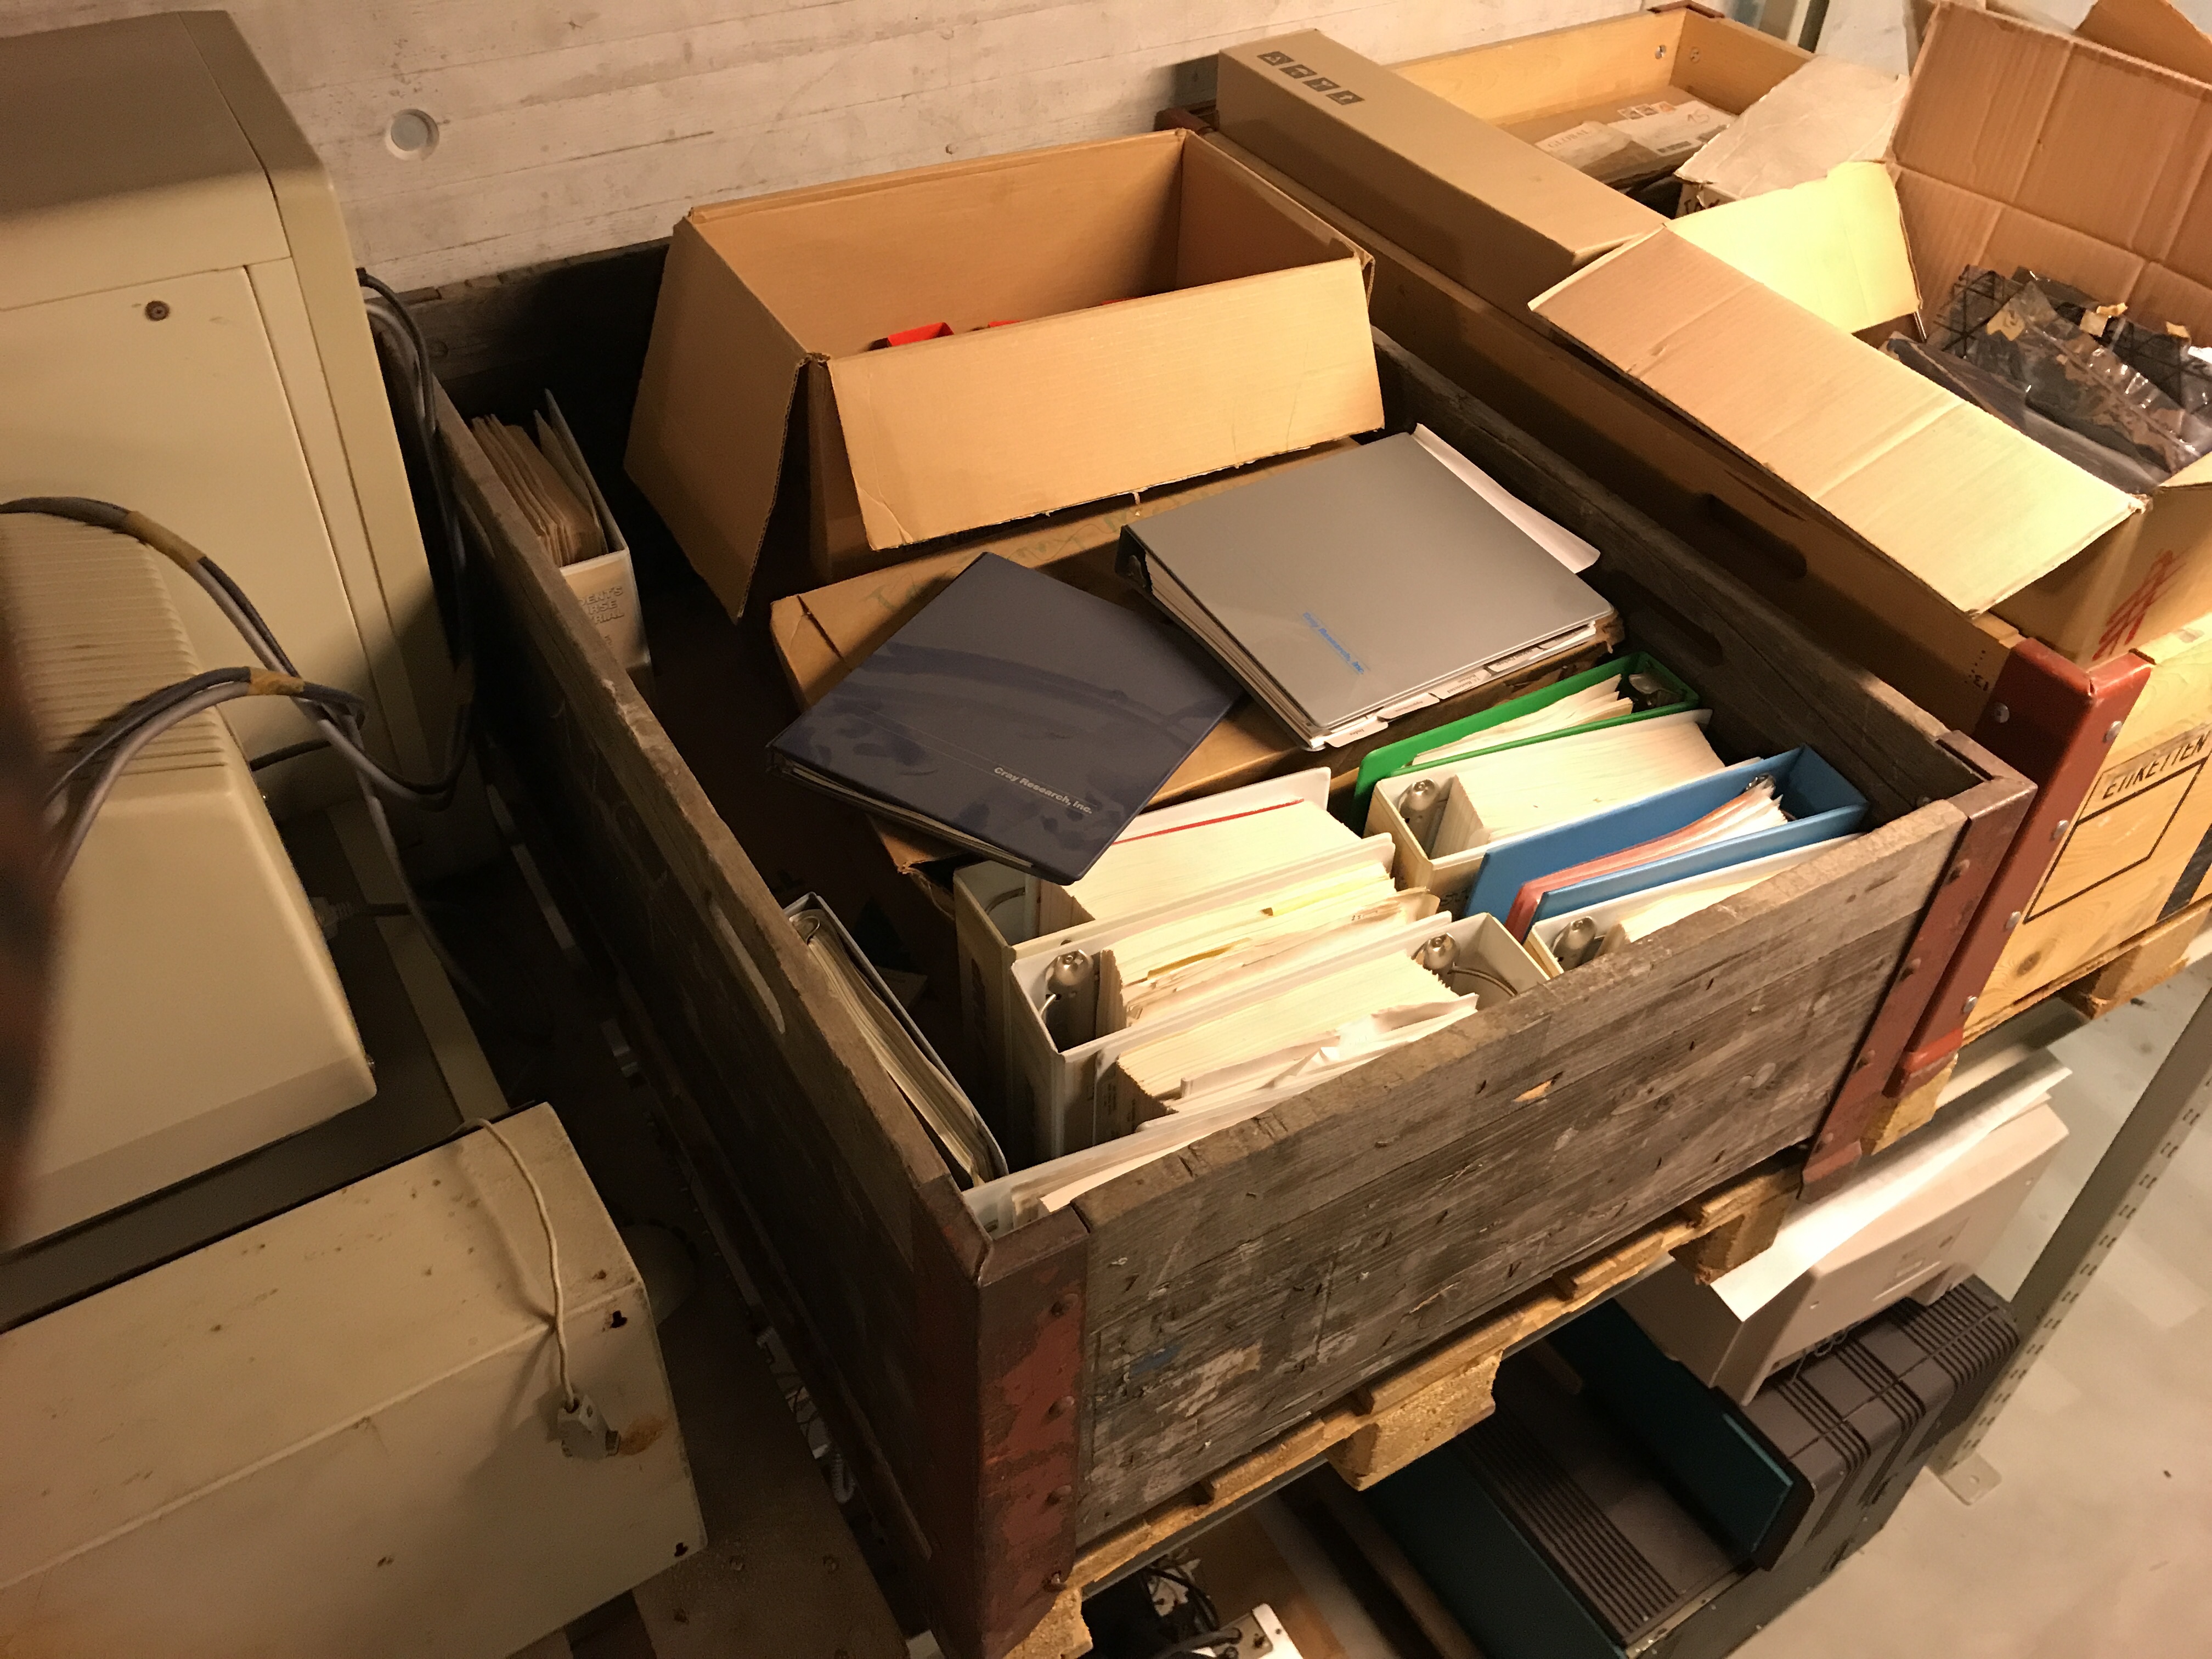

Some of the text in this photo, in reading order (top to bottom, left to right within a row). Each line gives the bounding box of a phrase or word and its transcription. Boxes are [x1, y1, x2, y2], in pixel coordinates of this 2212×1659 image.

[1350, 728, 1365, 737] Index
[994, 767, 1093, 814] Cray Research, Inc.
